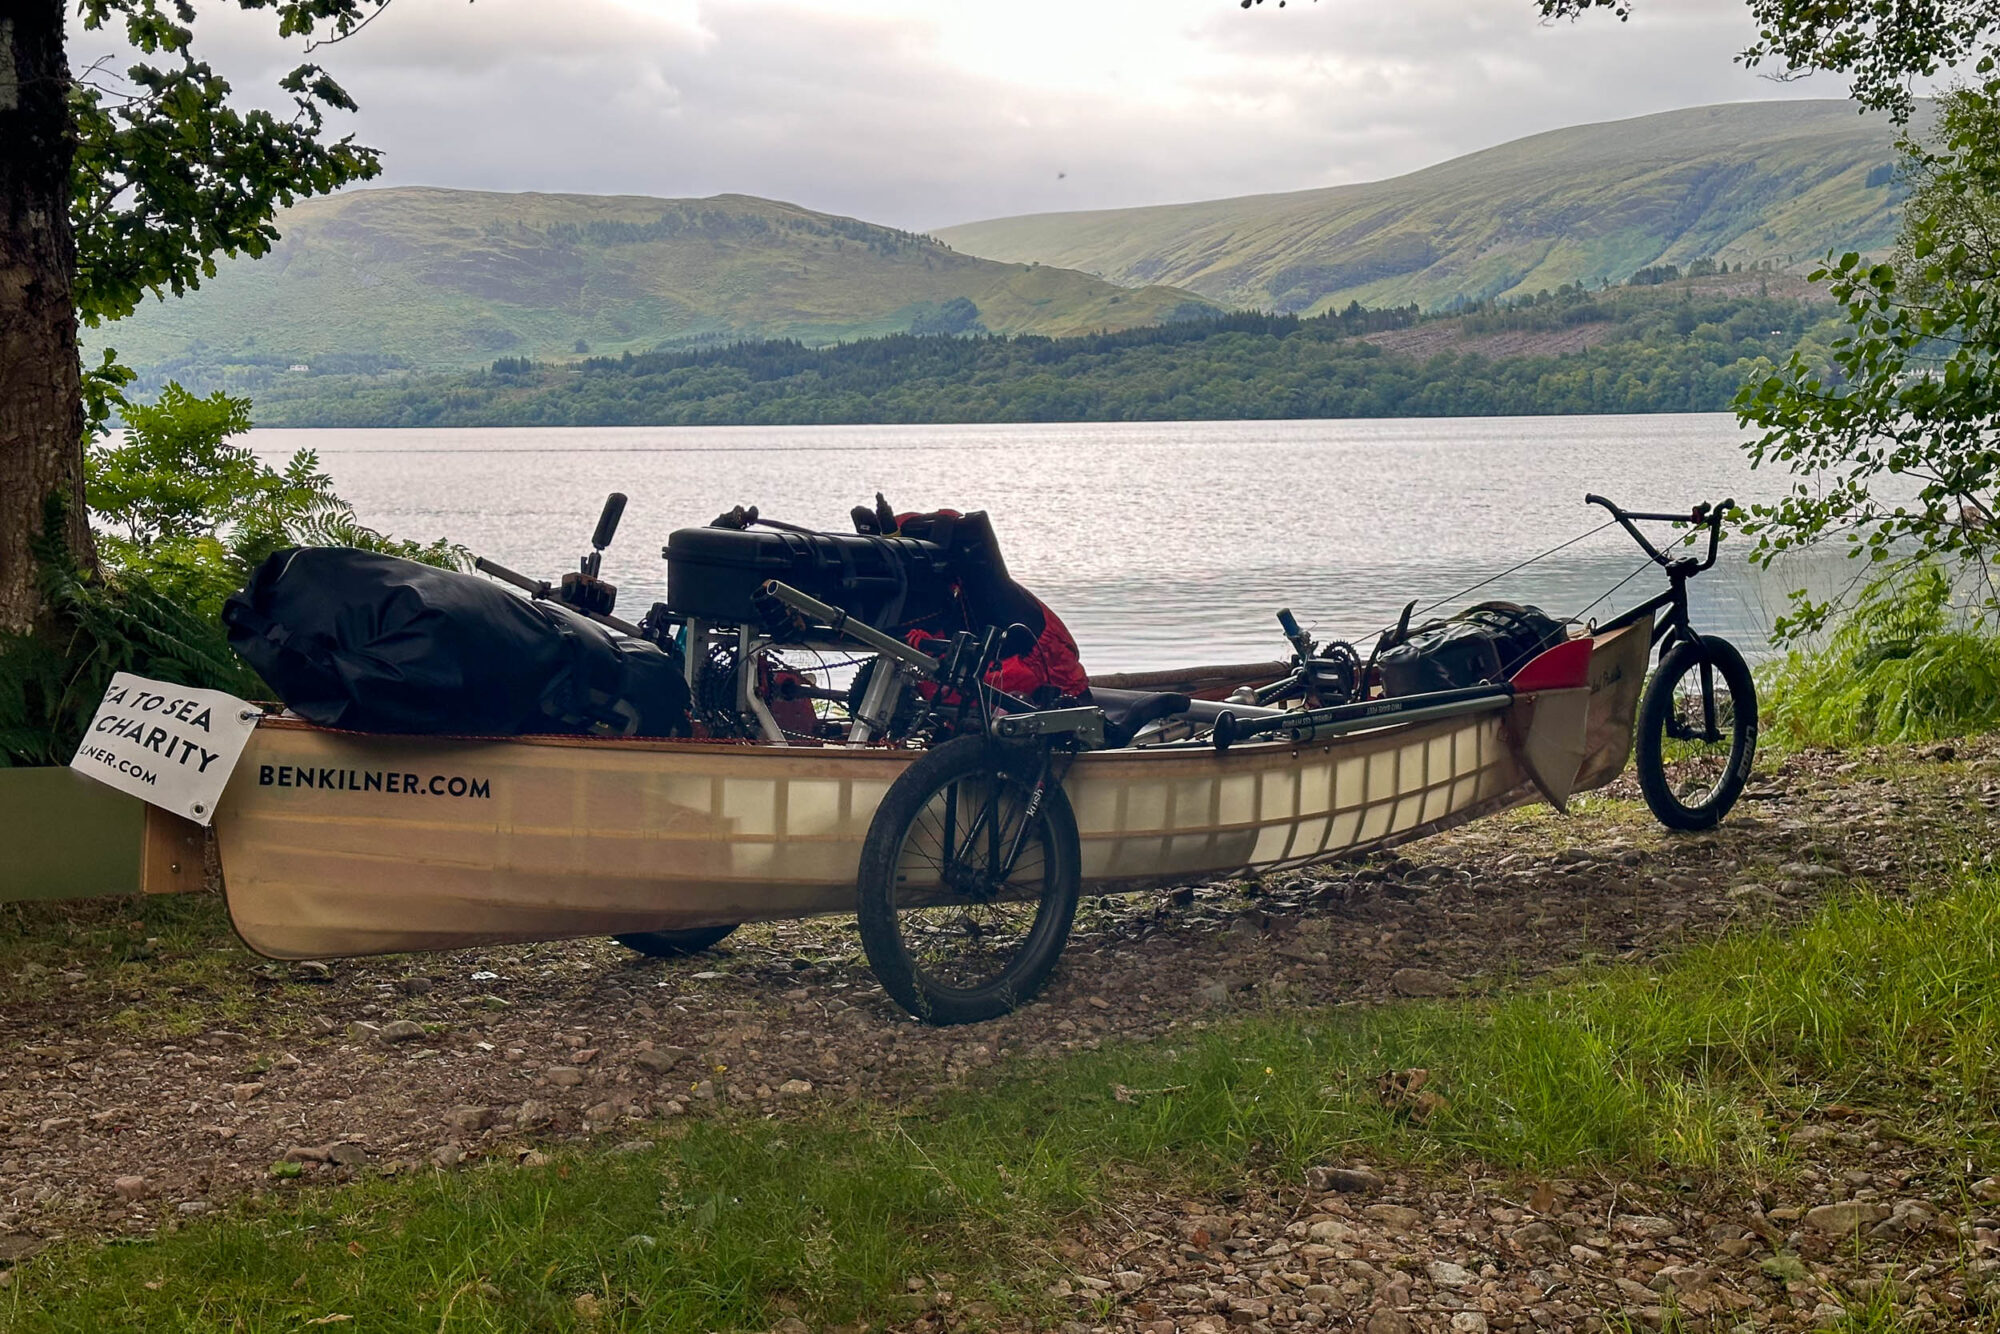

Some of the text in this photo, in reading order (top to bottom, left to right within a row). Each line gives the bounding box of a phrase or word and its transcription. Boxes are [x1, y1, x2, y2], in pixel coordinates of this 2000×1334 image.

[129, 692, 165, 711] TO
[162, 699, 212, 732] SEA
[95, 715, 220, 774] CHARITY
[259, 765, 490, 798] BENKILNER.COM
[1025, 788, 1043, 817] kush
